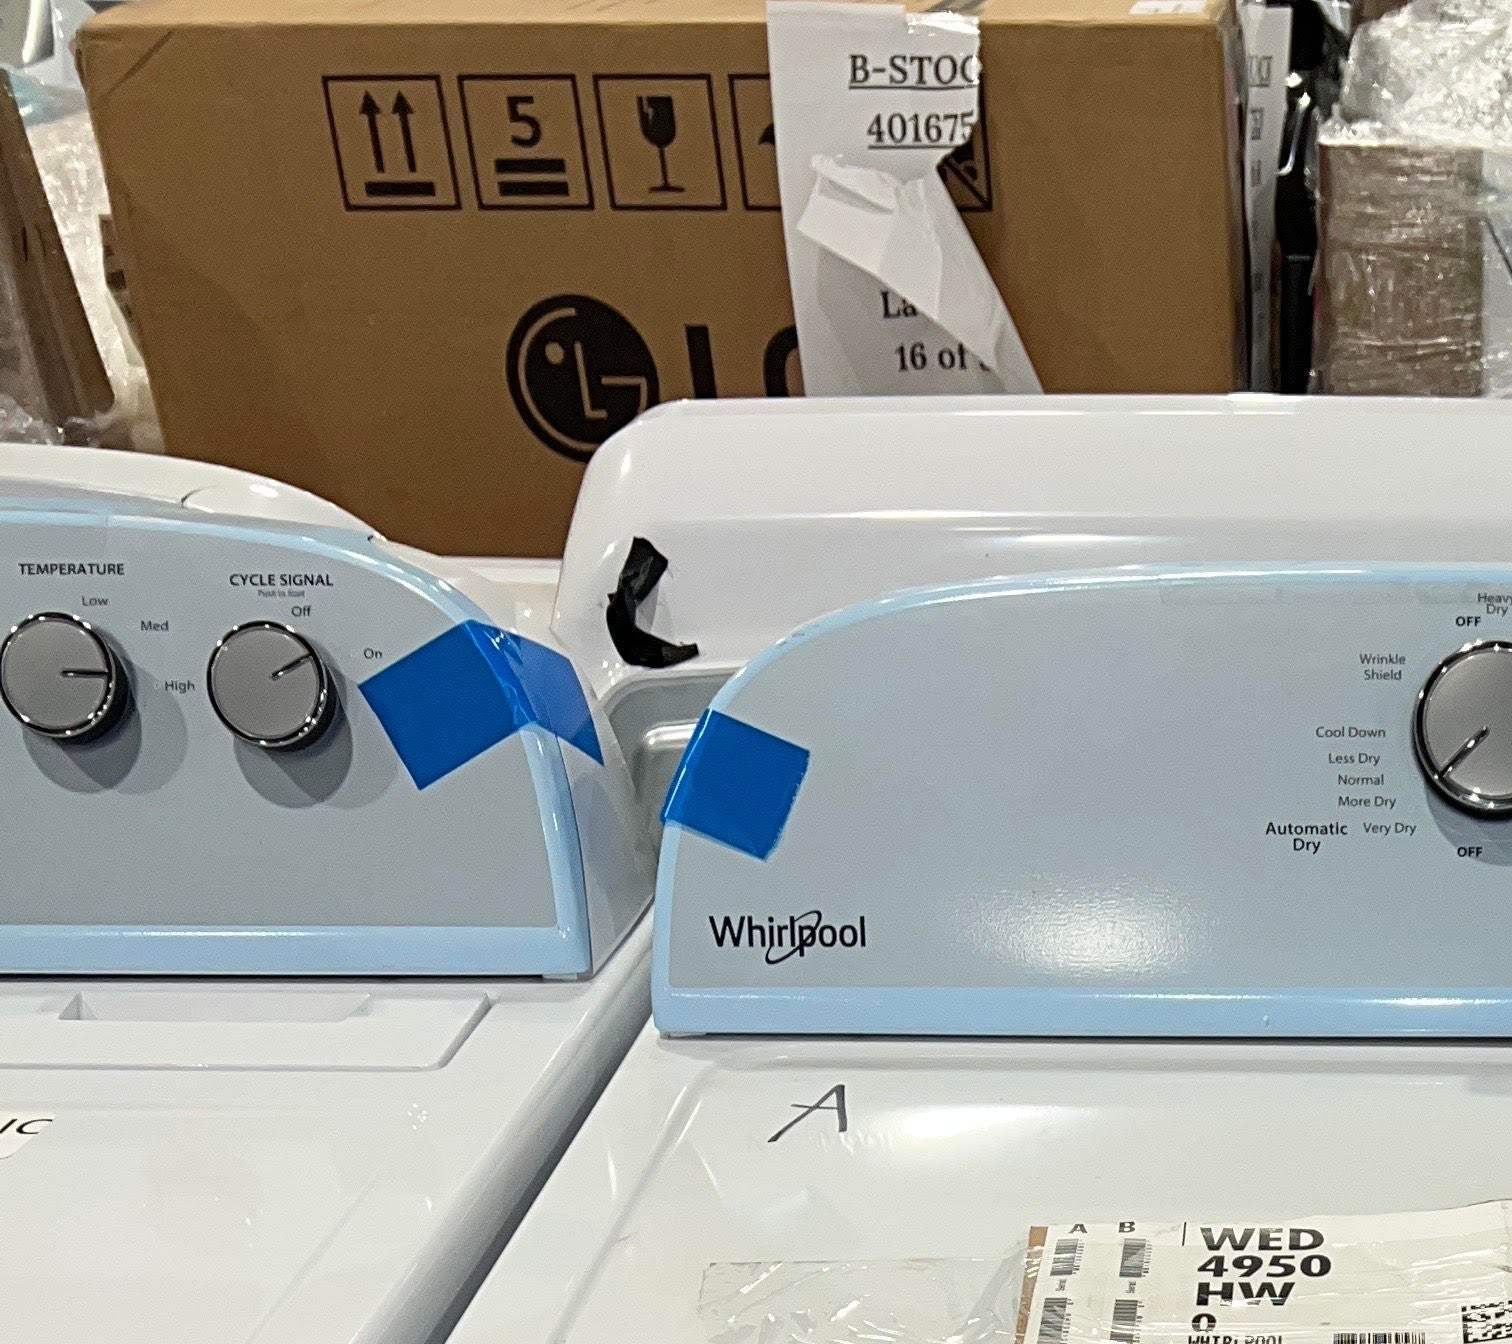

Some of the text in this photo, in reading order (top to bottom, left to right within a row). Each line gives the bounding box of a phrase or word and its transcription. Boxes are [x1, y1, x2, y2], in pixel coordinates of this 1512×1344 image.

[895, 342, 927, 372] 16
[18, 563, 125, 577] TEMPERATURE
[229, 573, 334, 586] CYCLE SIGNAL
[81, 595, 108, 607] Low
[291, 605, 311, 618] Off
[1486, 604, 1508, 617] Dry
[140, 620, 169, 632] Med
[1455, 616, 1481, 627] OFF
[364, 648, 383, 660] On
[1359, 653, 1406, 665] Wrinkle
[1364, 669, 1402, 681] Shield
[164, 680, 196, 695] High
[1316, 726, 1386, 738] Cool Down
[1328, 753, 1380, 768] Less Dry
[1338, 774, 1385, 786] Normal
[1338, 796, 1396, 811] More Dry
[1266, 822, 1348, 837] Automatic
[1363, 823, 1417, 838] Very Dry
[1293, 838, 1321, 855] Dry
[1457, 847, 1482, 858] OFF
[709, 910, 867, 964] Whirlpool
[767, 1084, 848, 1143] A
[1068, 1223, 1088, 1234] A
[1118, 1221, 1136, 1233] B
[1200, 1227, 1325, 1251] WED
[1197, 1255, 1332, 1278] 4950
[1196, 1282, 1295, 1307] HW
